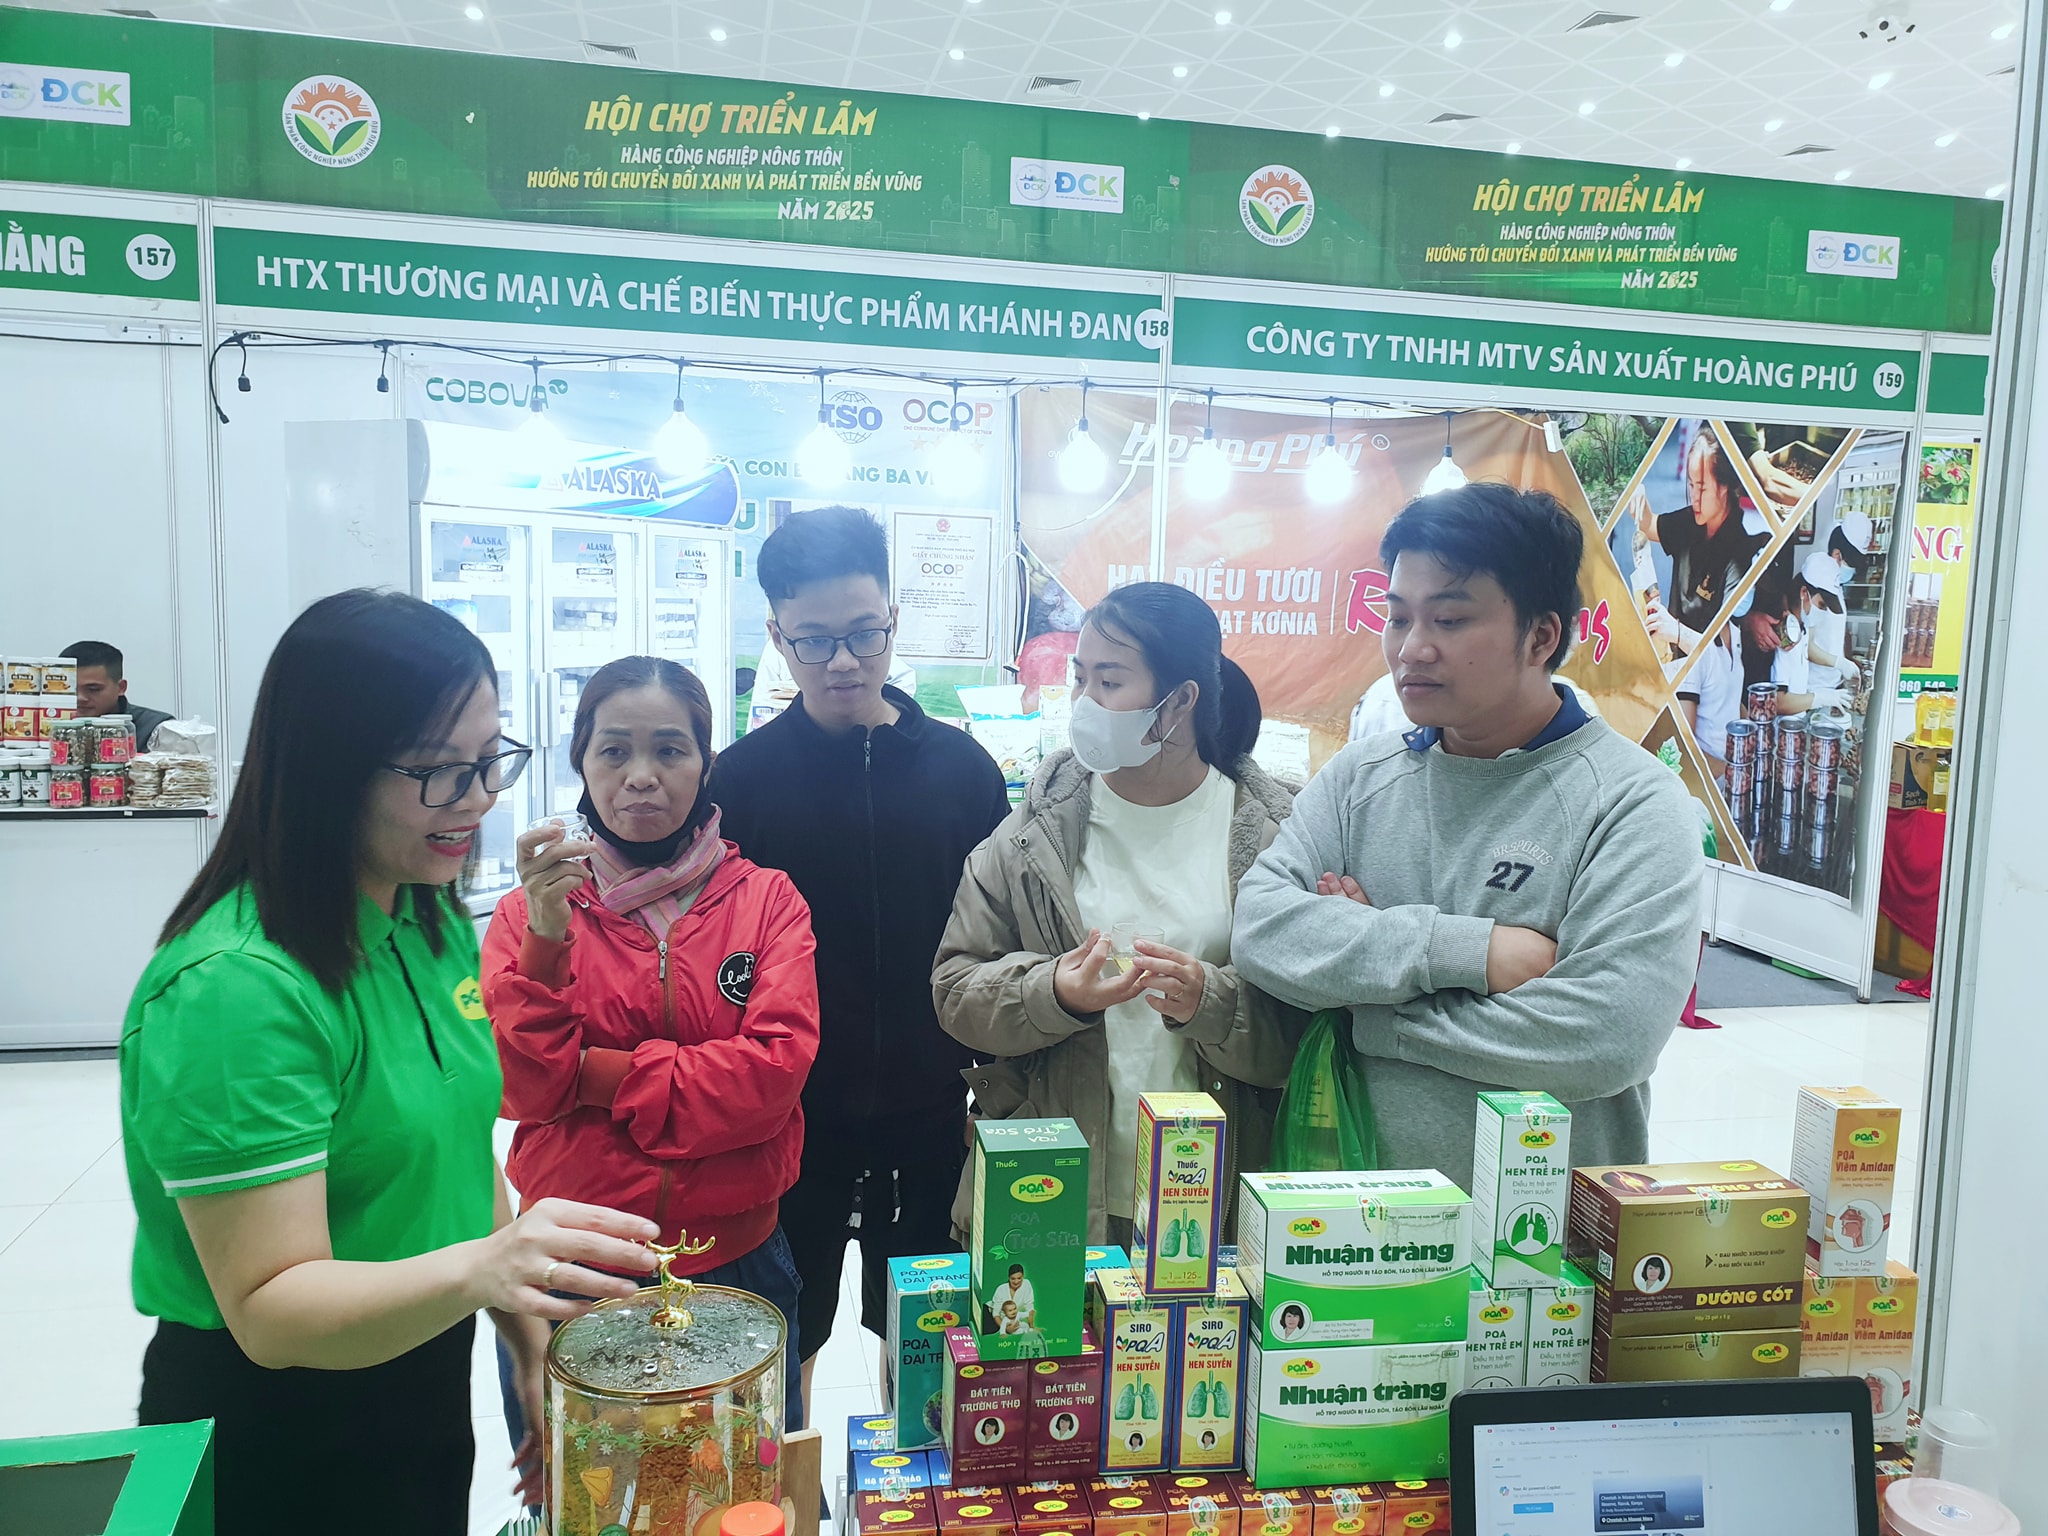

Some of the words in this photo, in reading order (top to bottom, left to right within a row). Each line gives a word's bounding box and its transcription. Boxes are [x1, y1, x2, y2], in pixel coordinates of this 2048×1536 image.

[584, 94, 643, 137] HỘI
[649, 101, 713, 138] CHỢ
[720, 91, 808, 135] TRIỂN
[811, 100, 878, 136] LÃM
[620, 143, 661, 164] HÀNG
[665, 144, 703, 165] CÔNG
[706, 145, 758, 168] NGHIỆP
[761, 145, 800, 166] NÔNG
[805, 146, 843, 166] THÔN
[527, 166, 579, 188] HƯỚNG
[583, 166, 608, 189] TỚI
[611, 165, 669, 189] CHUYỂN
[671, 165, 698, 190] ĐỔI
[700, 173, 742, 190] XANH
[746, 169, 765, 190] VÀ
[768, 168, 807, 191] PHÁT
[811, 166, 850, 191] TRIỂN
[853, 168, 882, 191] BỀN
[885, 170, 922, 191] VỮNG
[1472, 178, 1520, 216] HỘI
[1523, 183, 1575, 217] CHỢ
[1579, 173, 1650, 213] TRIỂN
[1652, 181, 1705, 213] LÃM
[777, 197, 820, 220] NĂM
[823, 200, 874, 221] 2025
[1500, 222, 1533, 240] HÀNG
[1535, 222, 1565, 241] CÔNG
[1567, 222, 1609, 243] NGHIỆP
[1610, 222, 1642, 241] NÔNG
[1645, 222, 1676, 241] THÔN
[0, 220, 86, 276] ẰNG
[134, 246, 171, 266] 157
[1425, 243, 1467, 262] HƯỚNG
[1470, 243, 1489, 262] TỚI
[1491, 241, 1538, 263] CHUYỂN
[1539, 241, 1560, 263] ĐỔI
[1561, 247, 1594, 263] XANH
[1598, 244, 1613, 262] VÀ
[1615, 244, 1646, 262] PHÁT
[1649, 241, 1681, 262] TRIỂN
[1682, 242, 1705, 262] BỀN
[1707, 244, 1738, 262] VỮNG
[1621, 268, 1655, 289] NĂM
[257, 255, 328, 291] HTX
[335, 261, 487, 301] THƯƠNG
[497, 273, 559, 313] MẠI
[565, 272, 610, 308] VÀ
[618, 275, 683, 313] CHẾ
[690, 278, 760, 319] BIẾN
[767, 290, 853, 331] THỰC
[861, 290, 950, 333] PHẨM
[958, 301, 1062, 339] KHÁNH
[1069, 310, 1132, 342] ĐAN
[1140, 320, 1169, 338] 158
[1246, 321, 1335, 357] CÔNG
[1342, 331, 1381, 360] TY
[1386, 334, 1470, 366] TNHH
[1478, 341, 1543, 370] MTV
[1549, 340, 1607, 376] SẢN
[1613, 347, 1688, 381] XUẤT
[1692, 355, 1794, 388] HOÀNG
[1800, 362, 1858, 392] PHÚ
[1878, 371, 1902, 388] 159
[903, 398, 993, 427] OCOP
[745, 460, 787, 477] CON
[886, 468, 911, 485] BA
[568, 466, 662, 499] ALASKA
[921, 562, 964, 575] OCOP
[1255, 568, 1322, 603] TƯƠI
[1213, 610, 1243, 639] ẠT
[1485, 861, 1534, 893] 27
[1525, 1135, 1543, 1143] PQA
[995, 1159, 1018, 1168] Thuốc
[1525, 1155, 1548, 1164] PQA
[1837, 1150, 1855, 1161] PQA
[1177, 1159, 1199, 1170] Thuốc
[1505, 1168, 1527, 1176] HEN
[1530, 1165, 1548, 1176] TRẺ
[1551, 1168, 1565, 1176] EM
[1176, 1168, 1206, 1185] PQA
[1018, 1183, 1045, 1195] PQA
[1163, 1187, 1180, 1197] HEN
[1293, 1223, 1314, 1232] PQA
[1285, 1242, 1374, 1266] Nhuận
[1379, 1241, 1454, 1263] tràng
[900, 1269, 928, 1277] PQA
[1762, 1285, 1794, 1303] CỐT
[1130, 1323, 1151, 1333] SIRO
[1201, 1320, 1223, 1330] SIRO
[1444, 1316, 1452, 1327] 5
[1855, 1318, 1873, 1329] PQA
[1197, 1329, 1237, 1351] PQA
[1485, 1330, 1506, 1339] PQA
[1552, 1328, 1573, 1336] PQA
[902, 1338, 931, 1350] PQA
[1125, 1332, 1165, 1353] PQA
[1466, 1343, 1486, 1352] HEN
[1489, 1339, 1507, 1351] TRẺ
[1509, 1340, 1523, 1349] EM
[1533, 1340, 1554, 1349] HEN
[1557, 1336, 1574, 1347] TRẺ
[1577, 1338, 1590, 1346] EM
[1117, 1362, 1132, 1372] HEN
[1188, 1360, 1205, 1369] HEN
[991, 1384, 1012, 1395] TIÊN
[1066, 1381, 1086, 1392] TIÊN
[1279, 1383, 1367, 1406] Nhuận
[1373, 1380, 1447, 1401] tràng
[960, 1400, 999, 1412] TRƯỜNG
[1001, 1399, 1021, 1409] THỌ
[1035, 1396, 1073, 1408] TRƯỜNG
[1075, 1395, 1095, 1405] THỌ
